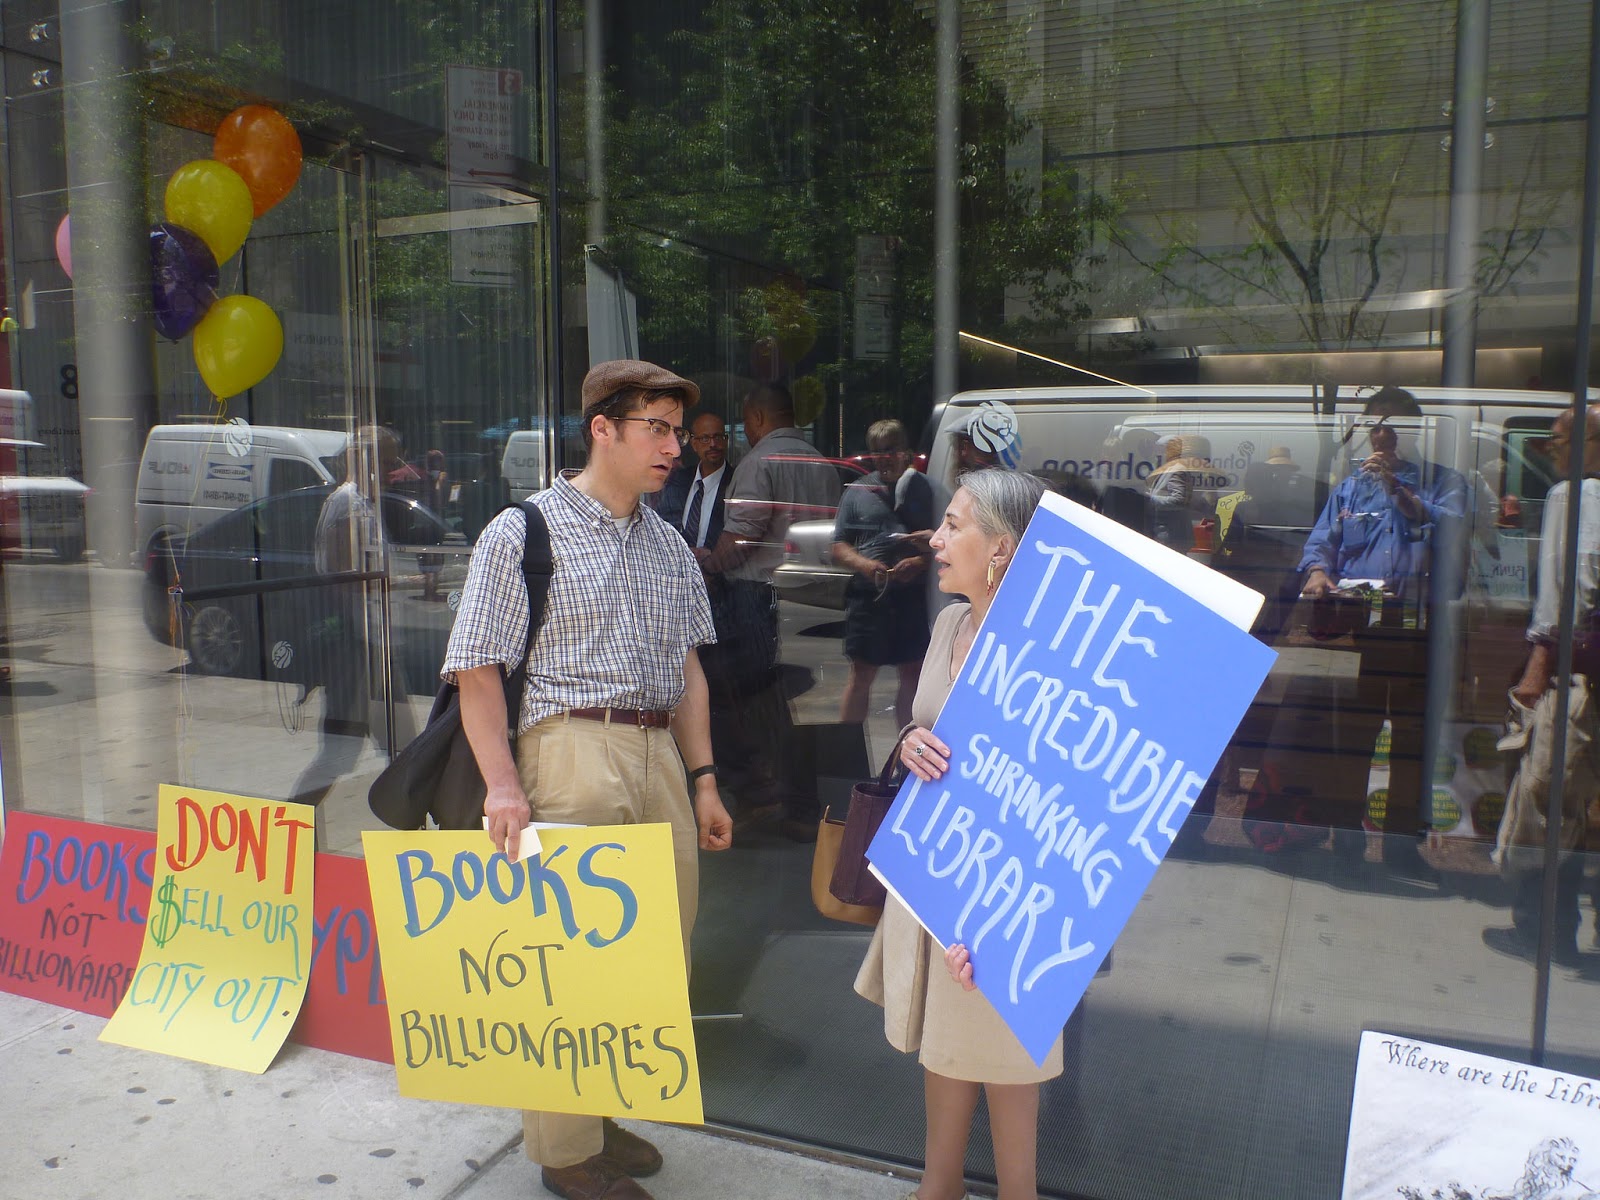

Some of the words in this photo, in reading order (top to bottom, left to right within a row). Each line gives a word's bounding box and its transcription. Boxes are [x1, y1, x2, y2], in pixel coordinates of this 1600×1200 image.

[1023, 540, 1172, 708] THE
[967, 632, 1206, 867] INCREDIBLE
[166, 797, 315, 895] DON'T
[960, 733, 1123, 909] SHRINKING
[41, 903, 106, 948] NOT
[242, 900, 303, 980] OUR
[396, 843, 639, 948] BOOKS
[890, 778, 1096, 1005] LIBRARY
[130, 961, 204, 1032] CITY
[459, 929, 565, 1006] NOT
[400, 1008, 690, 1110] BILLIONAIRES
[1381, 1040, 1449, 1075] Where
[1457, 1066, 1492, 1085] are
[1501, 1069, 1538, 1094] the
[1544, 1077, 1600, 1109] Libr
